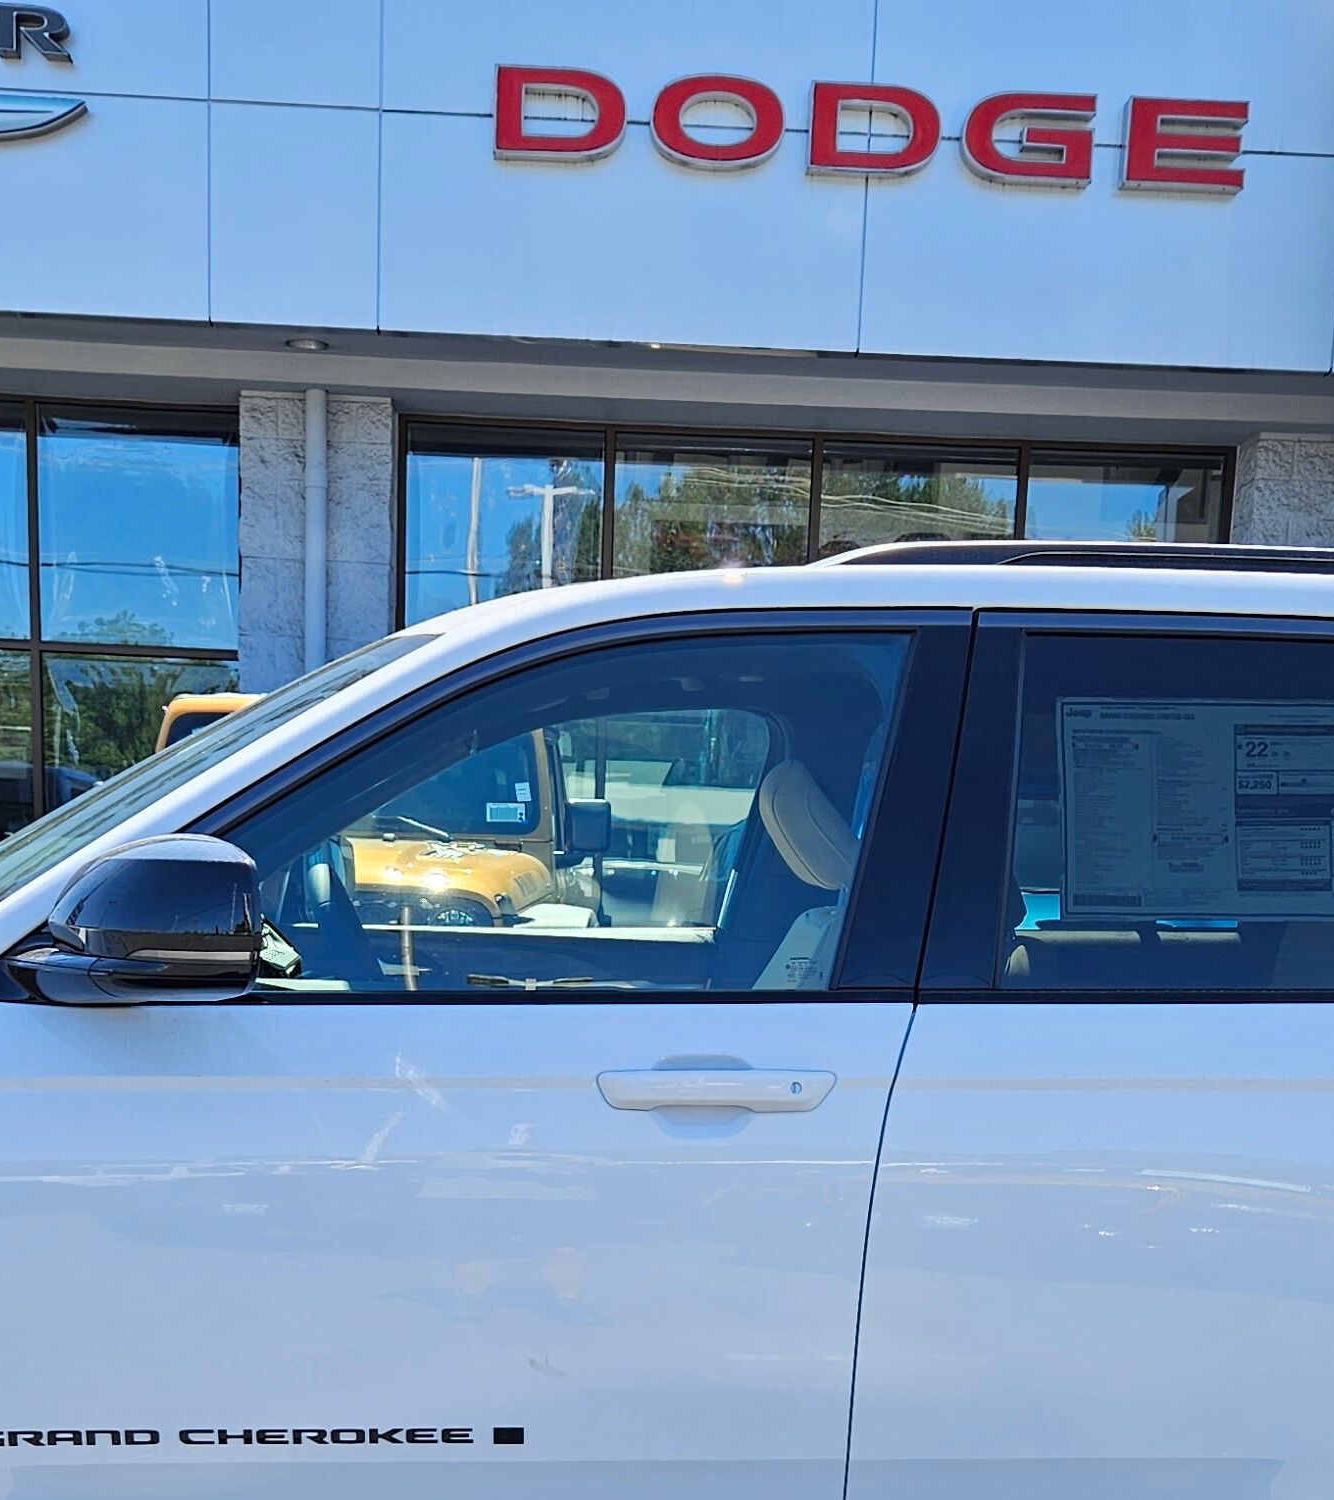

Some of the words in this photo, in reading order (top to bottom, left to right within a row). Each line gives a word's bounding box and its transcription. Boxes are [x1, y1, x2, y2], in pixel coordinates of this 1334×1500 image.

[493, 63, 1252, 196] DODGE
[1245, 741, 1269, 758] 22
[1237, 779, 1273, 790] $2,250
[178, 1426, 474, 1446] CHEROKEE
